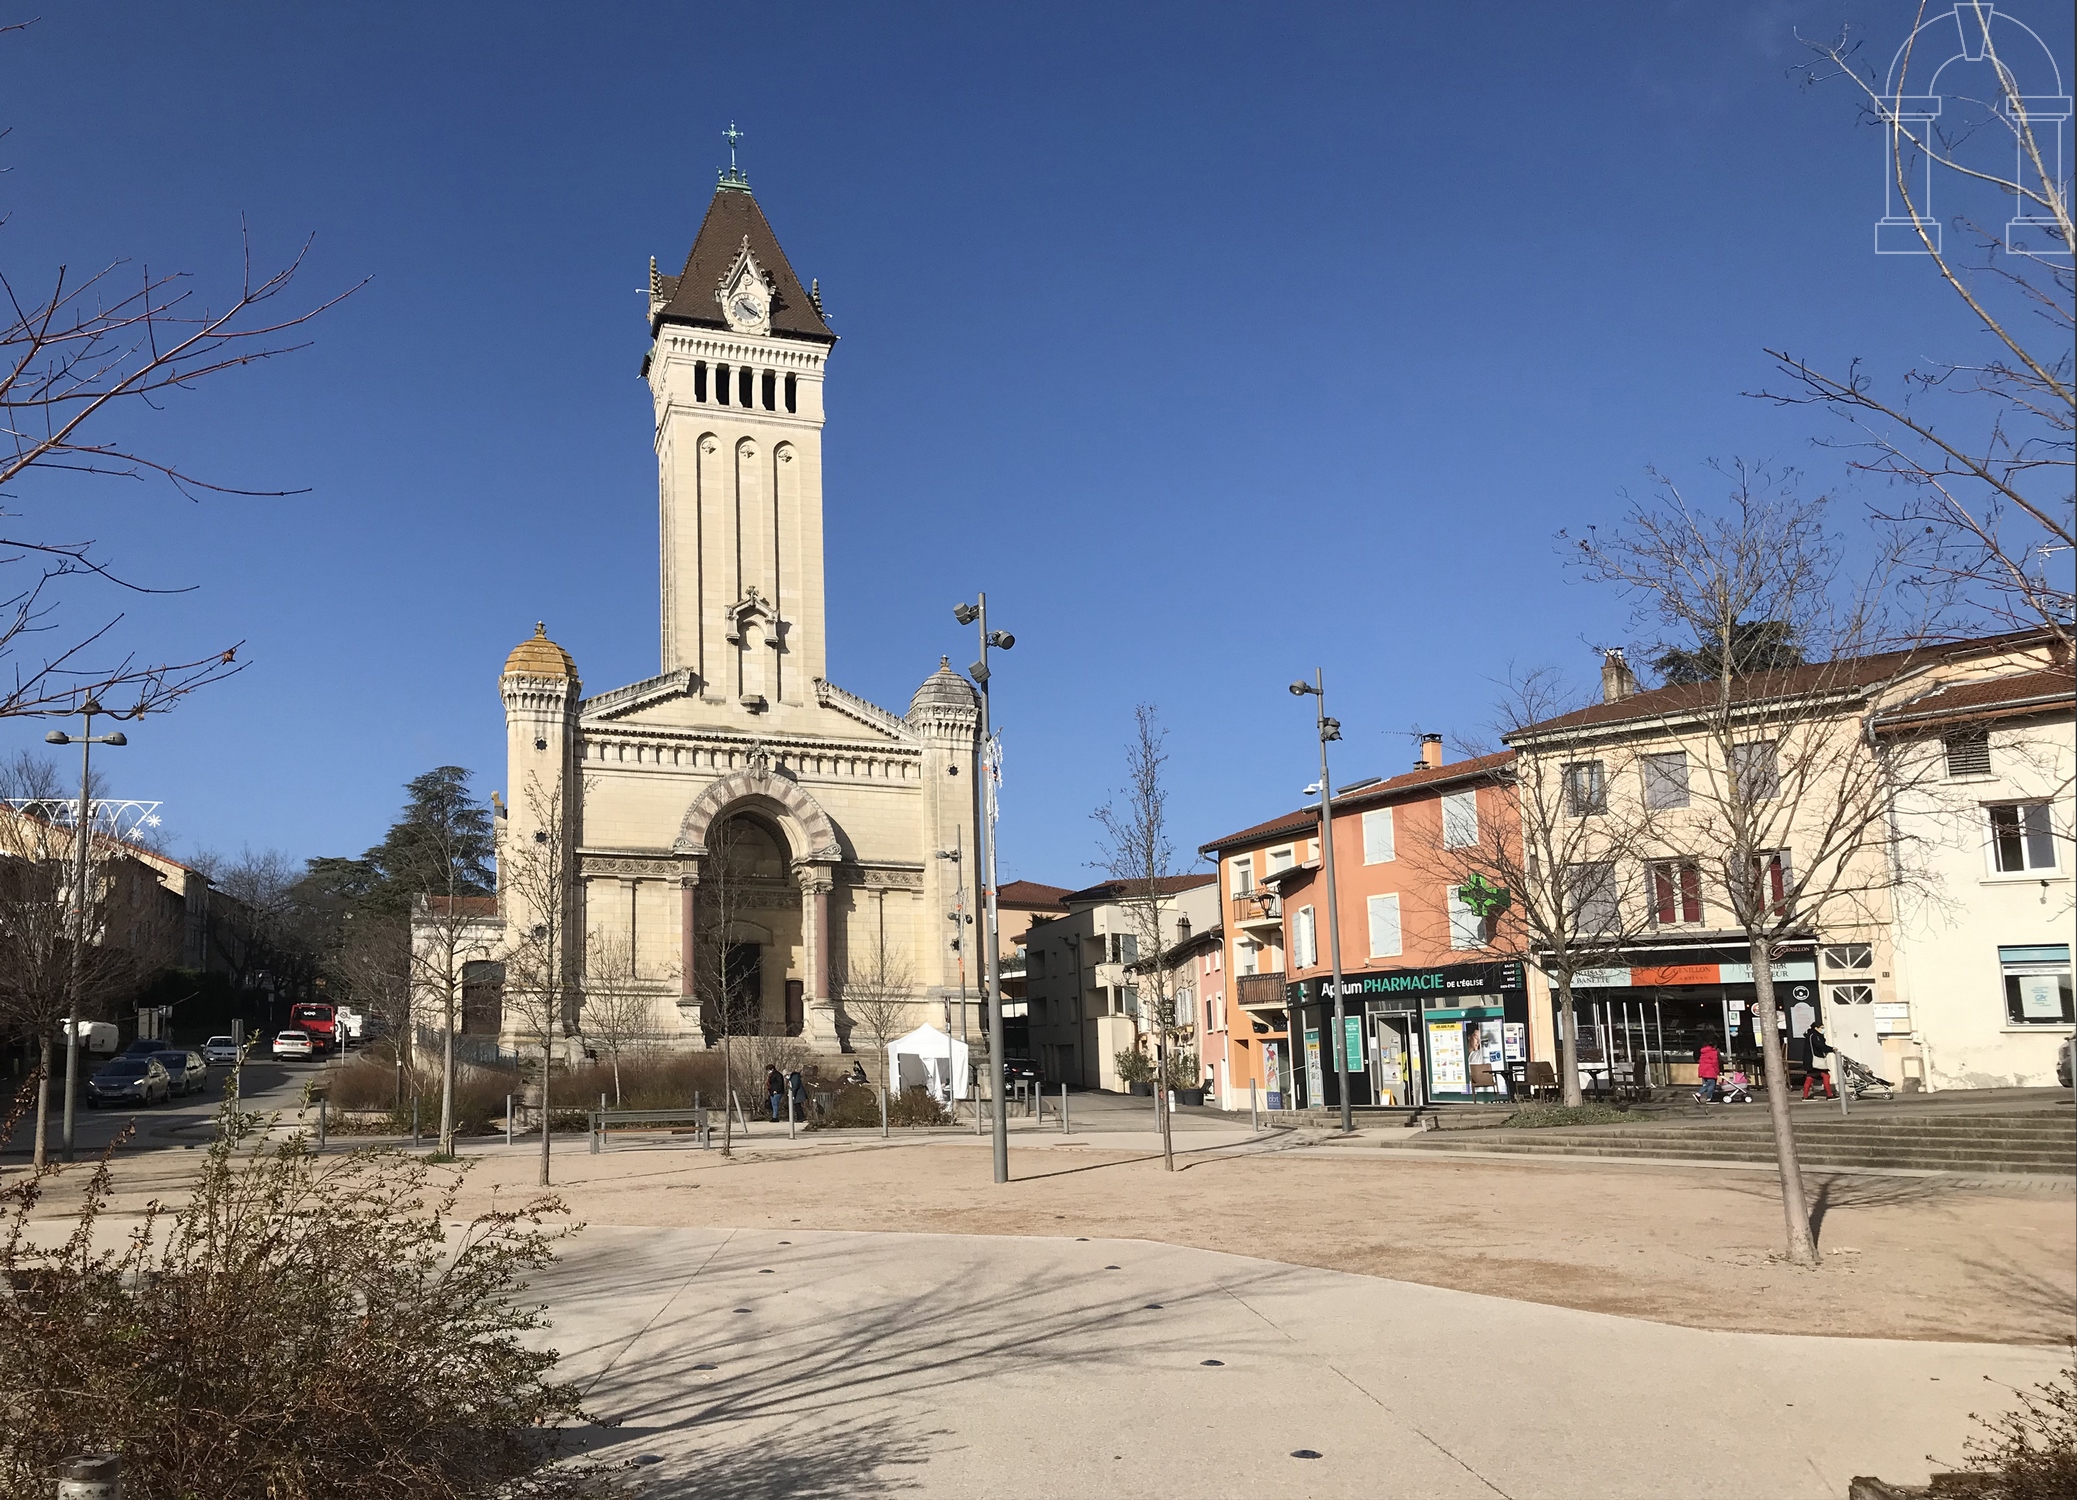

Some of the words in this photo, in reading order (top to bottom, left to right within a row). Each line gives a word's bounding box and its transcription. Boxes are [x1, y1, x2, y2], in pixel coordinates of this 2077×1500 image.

[1321, 980, 1363, 999] Apium
[1363, 973, 1445, 994] PHARMACIE
[1446, 981, 1456, 989] DE
[1456, 978, 1484, 988] L'ÉGLISE
